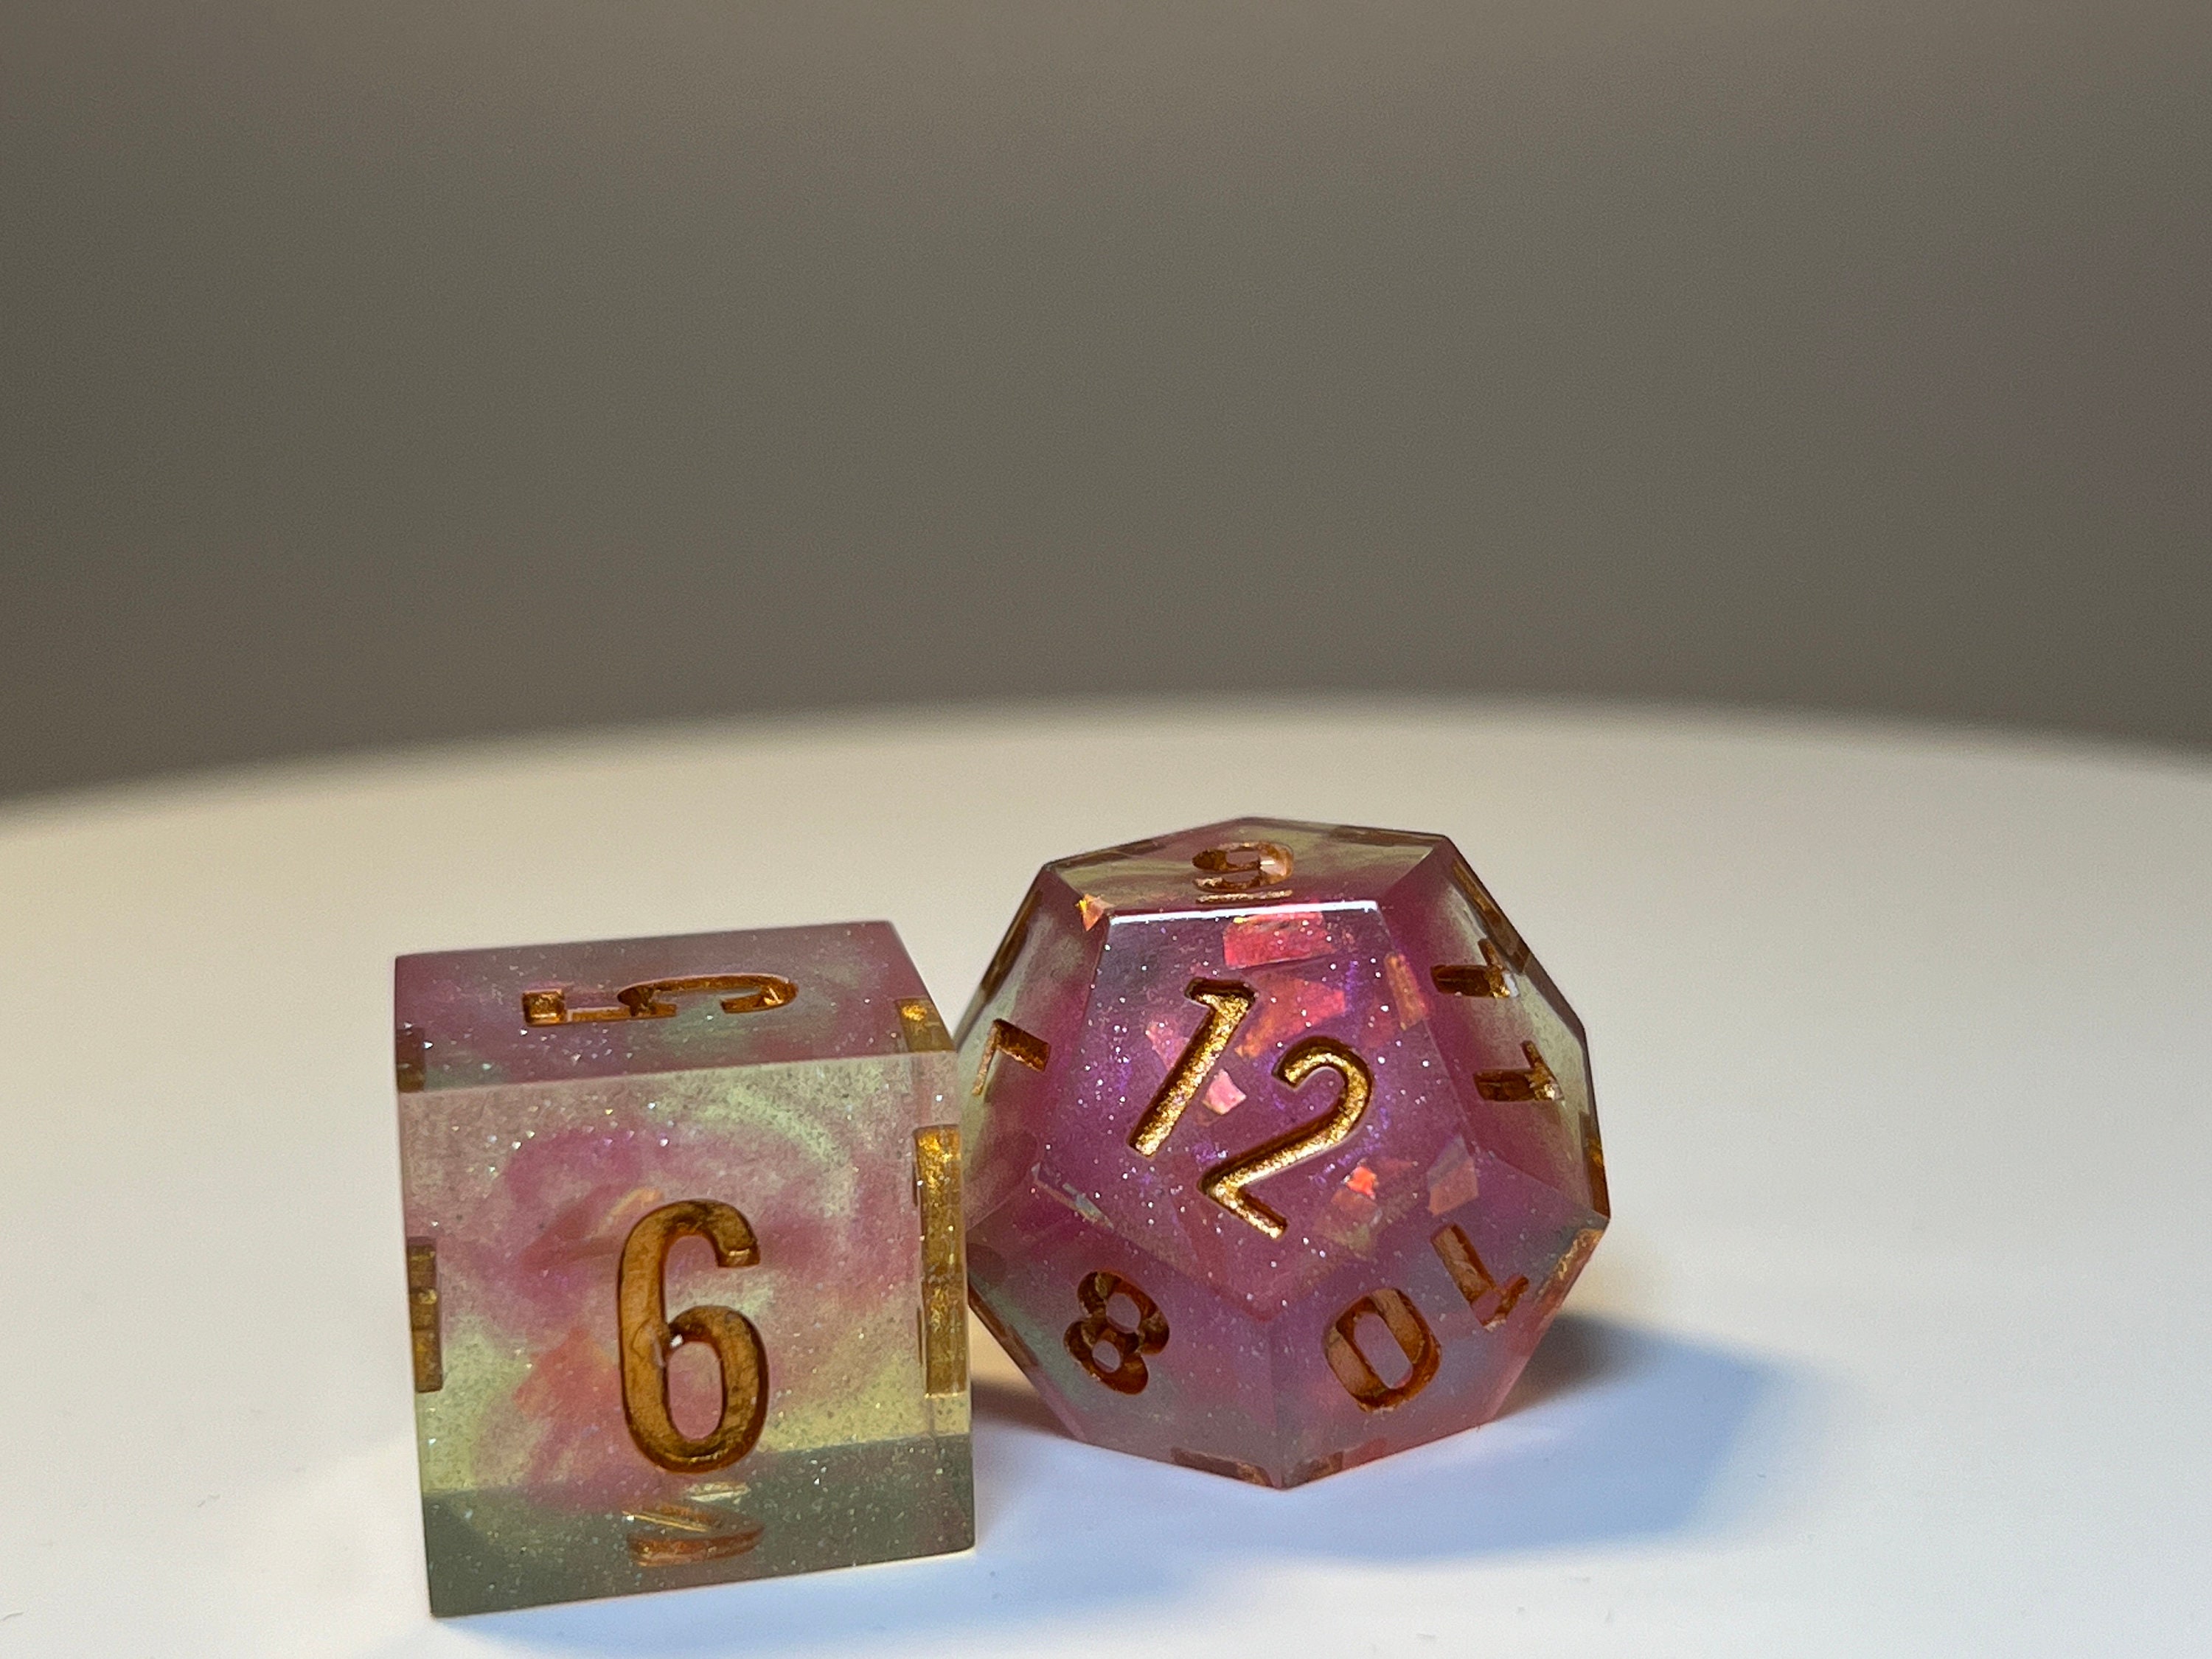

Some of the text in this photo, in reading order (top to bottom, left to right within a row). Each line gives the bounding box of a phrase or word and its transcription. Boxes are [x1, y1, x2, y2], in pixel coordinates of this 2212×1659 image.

[1128, 978, 1373, 1240] 12
[617, 1200, 769, 1473] 6
[1062, 1270, 1170, 1396] 8
[1323, 1223, 1530, 1413] 10
